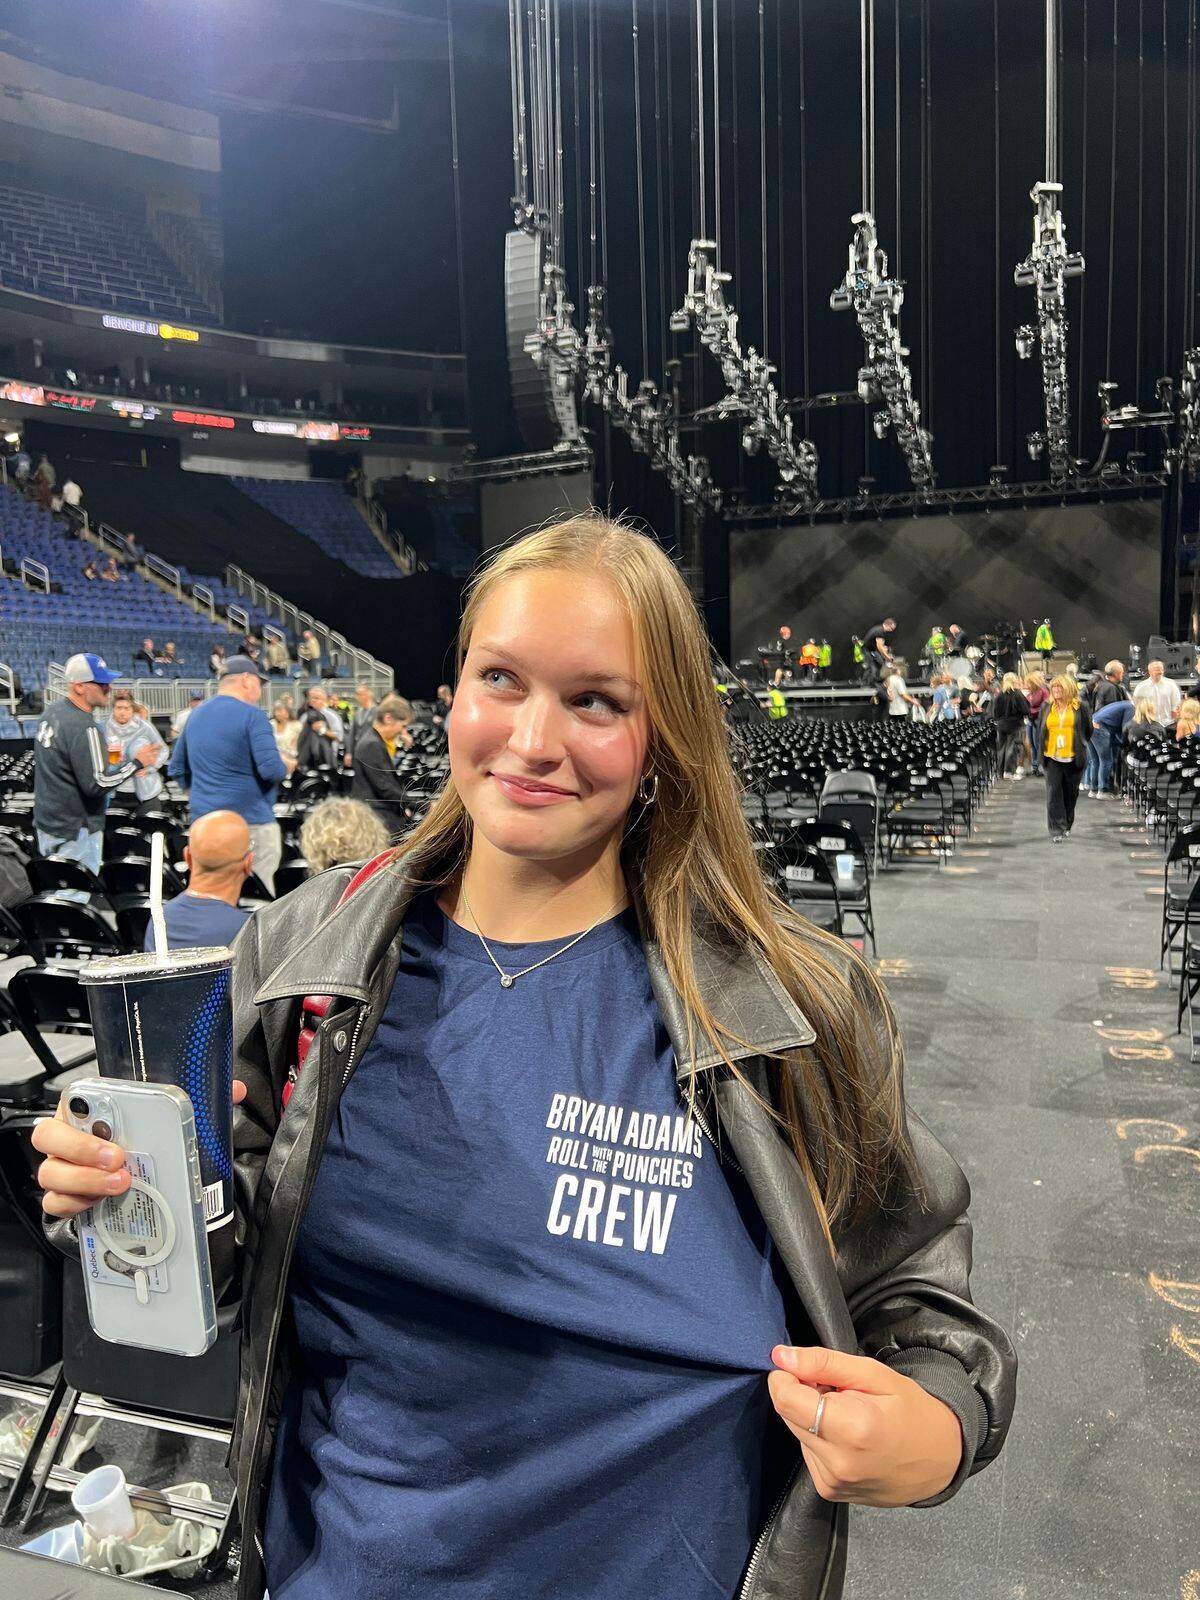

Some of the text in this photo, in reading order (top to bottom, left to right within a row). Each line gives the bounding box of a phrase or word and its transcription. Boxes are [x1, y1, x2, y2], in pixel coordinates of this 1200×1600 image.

[546, 1093, 703, 1159] BRYAN ADAMS
[546, 1136, 694, 1189] ROLL WITH THE PUNCHES
[546, 1173, 678, 1255] CREW
[91, 1250, 99, 1278] Québec
